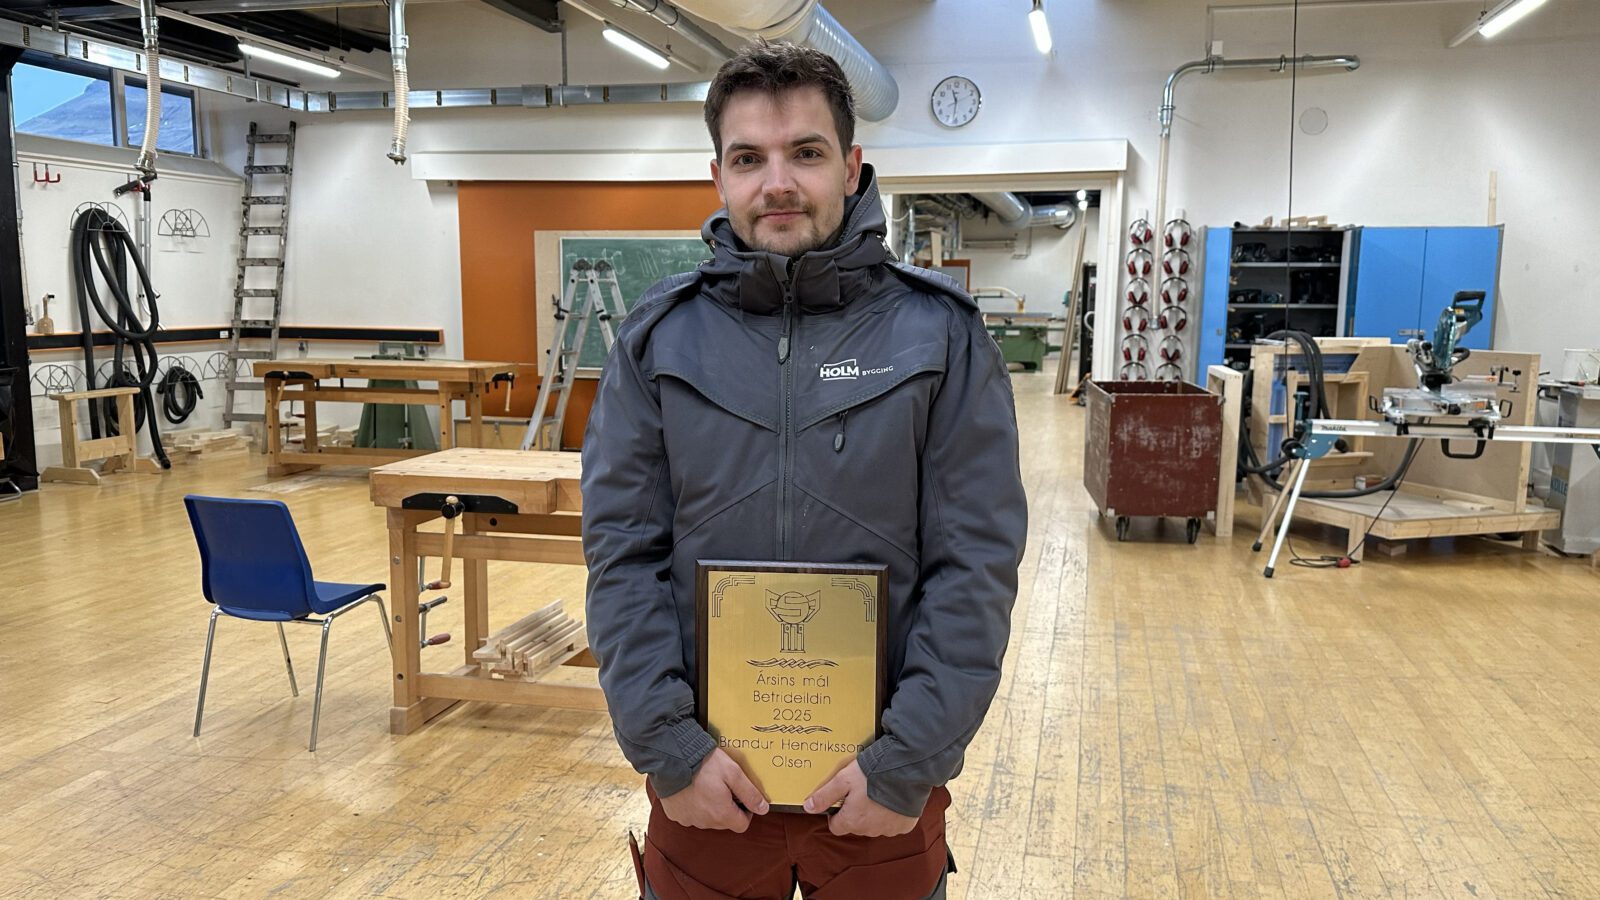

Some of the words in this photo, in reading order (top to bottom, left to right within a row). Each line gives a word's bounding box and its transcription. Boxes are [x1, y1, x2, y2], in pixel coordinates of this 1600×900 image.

[820, 365, 859, 378] HOLM
[862, 366, 894, 376] BYGGING
[756, 670, 795, 687] Ársins
[803, 674, 829, 688] mál
[753, 690, 831, 705] Betrideildin
[773, 708, 812, 722] 2025
[720, 736, 774, 750] Brandur
[781, 739, 865, 754] Hendriksson
[771, 755, 812, 769] Olsen
